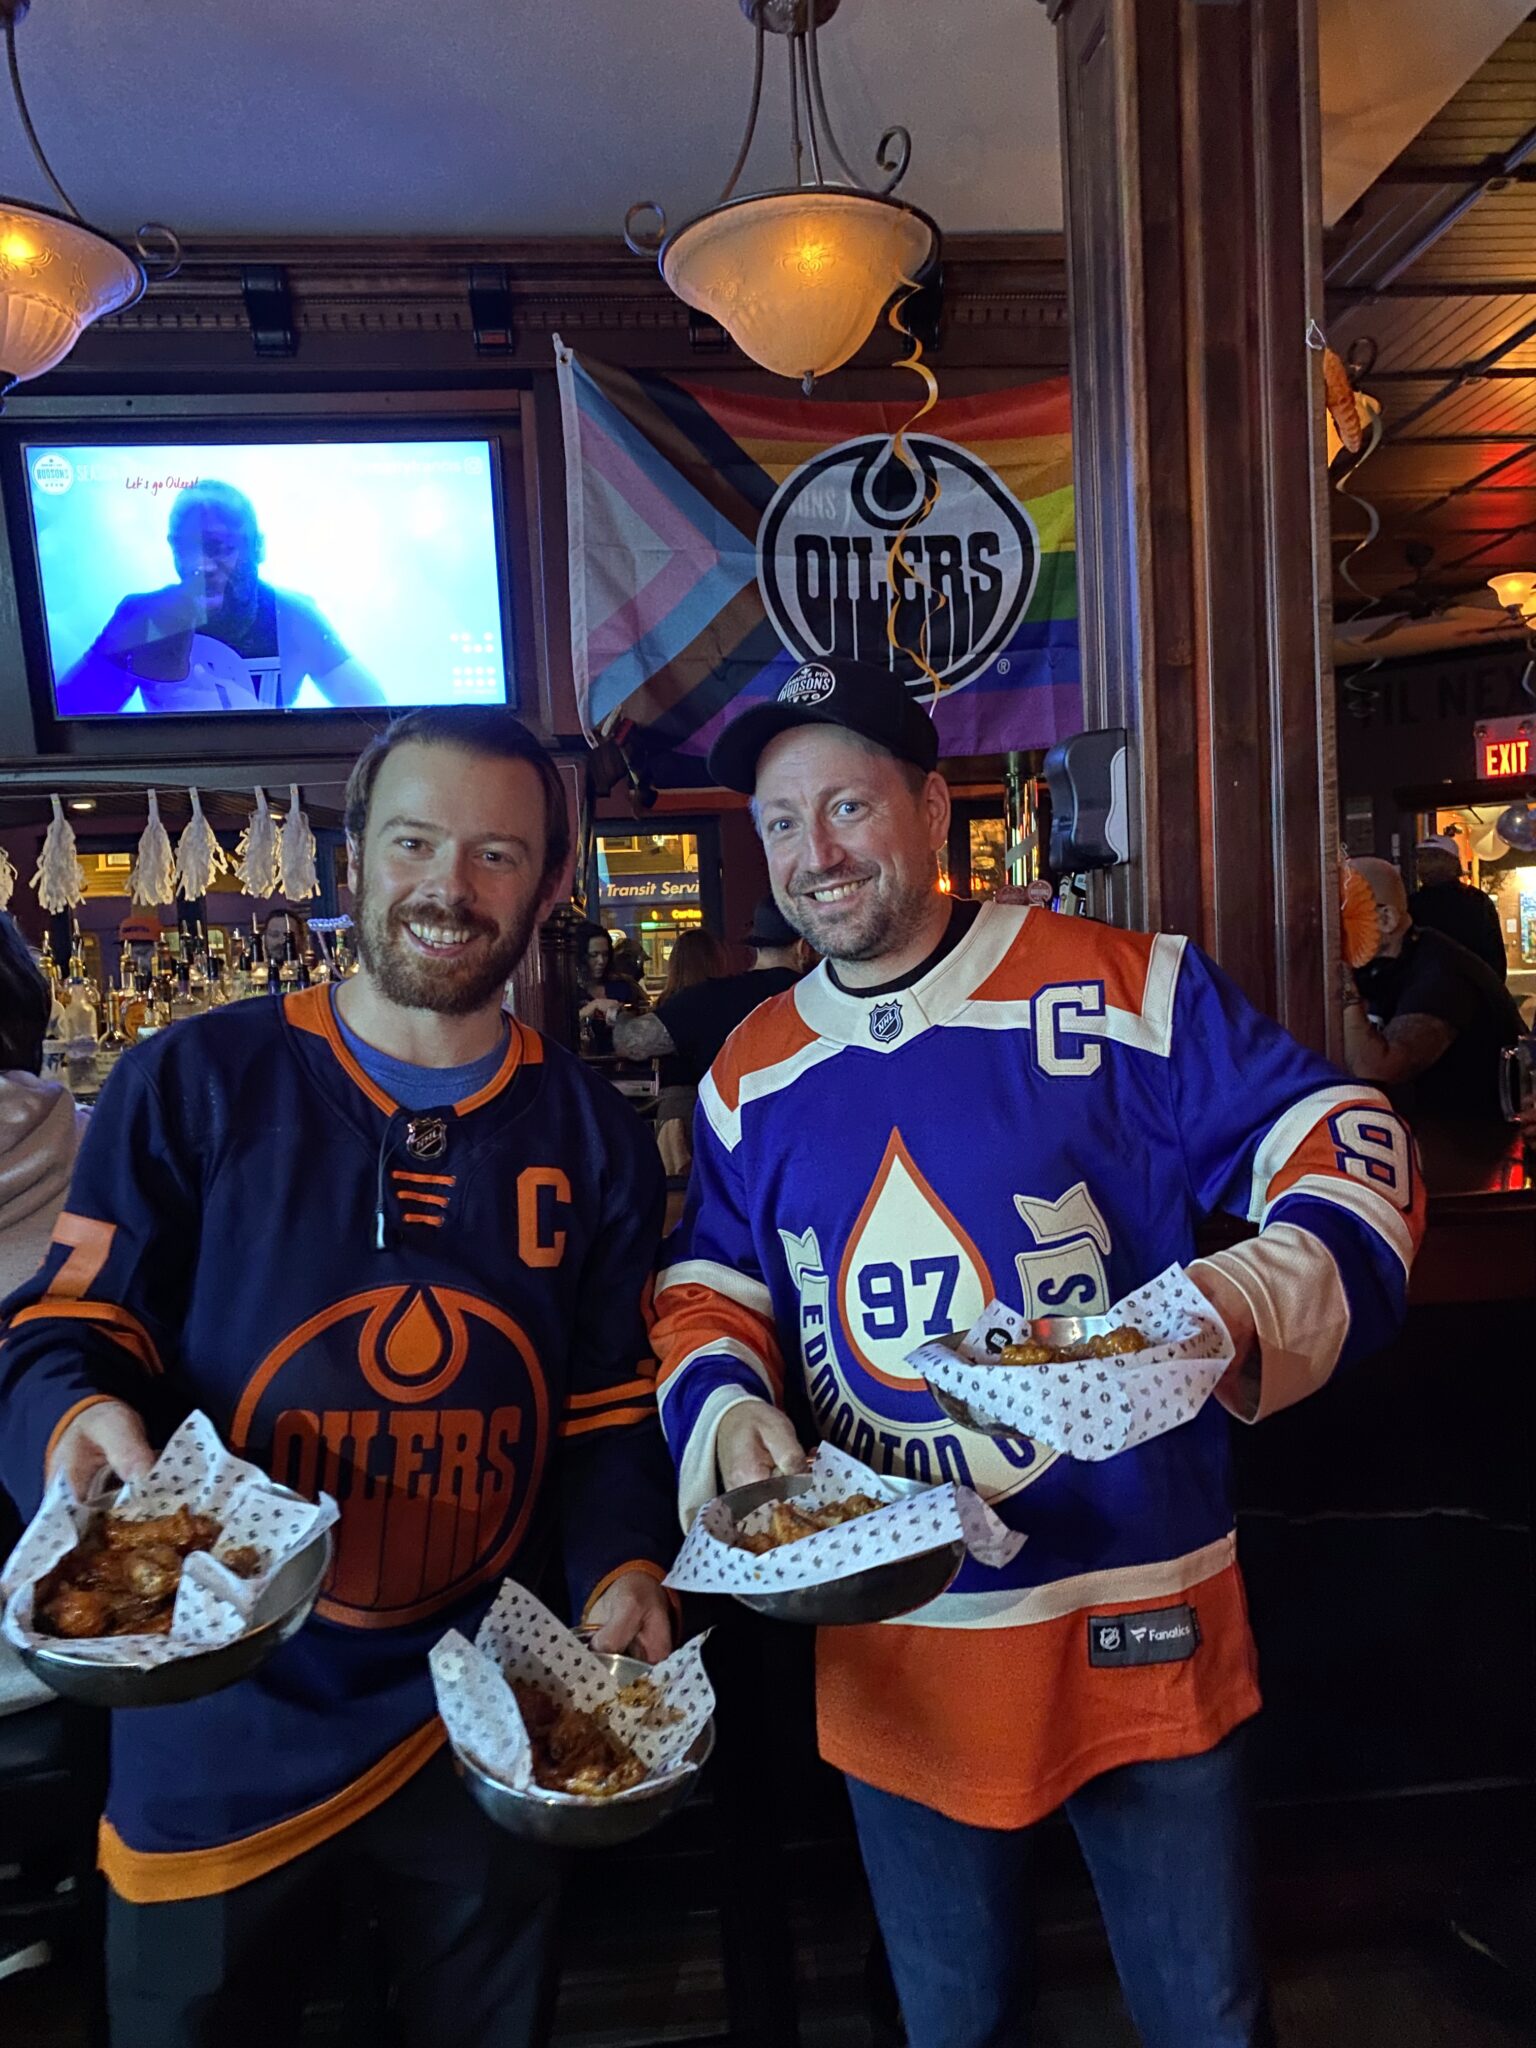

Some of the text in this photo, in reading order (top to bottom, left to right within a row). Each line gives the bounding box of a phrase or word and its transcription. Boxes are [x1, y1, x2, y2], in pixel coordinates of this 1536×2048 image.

[125, 476, 149, 490] Let's
[151, 482, 164, 496] go
[794, 532, 1003, 606] OILERS
[780, 677, 831, 698] HUDSONS
[1486, 741, 1529, 776] EXIT
[607, 881, 656, 897] Transit
[875, 1008, 893, 1033] NHL
[1030, 979, 1105, 1081] C
[516, 1166, 572, 1268] C
[857, 1254, 960, 1341] 97
[273, 1406, 522, 1515] OILERS
[1149, 1624, 1191, 1642] Fanatics
